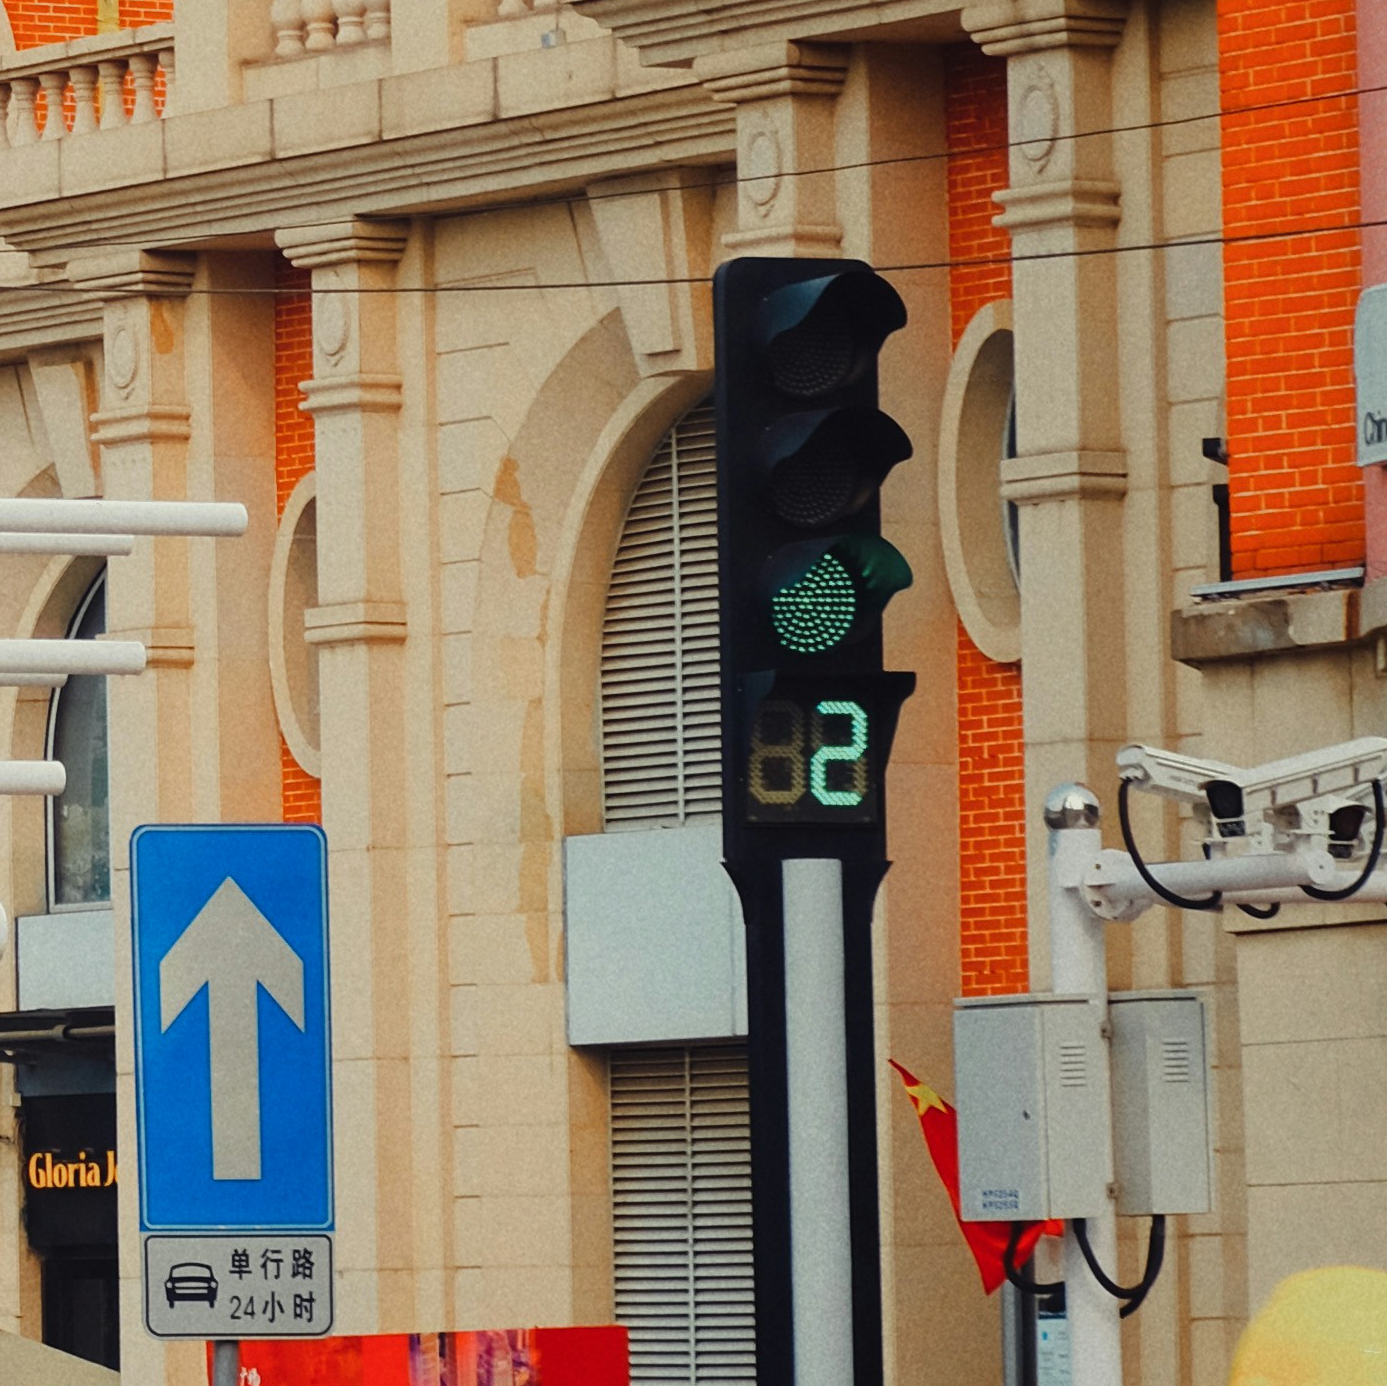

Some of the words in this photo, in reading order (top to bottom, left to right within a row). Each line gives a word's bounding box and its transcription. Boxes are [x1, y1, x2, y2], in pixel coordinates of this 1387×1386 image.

[811, 701, 868, 805] 2
[29, 1151, 101, 1188] Gloria
[229, 1247, 316, 1281] 单行路
[229, 1292, 317, 1324] 24小时
